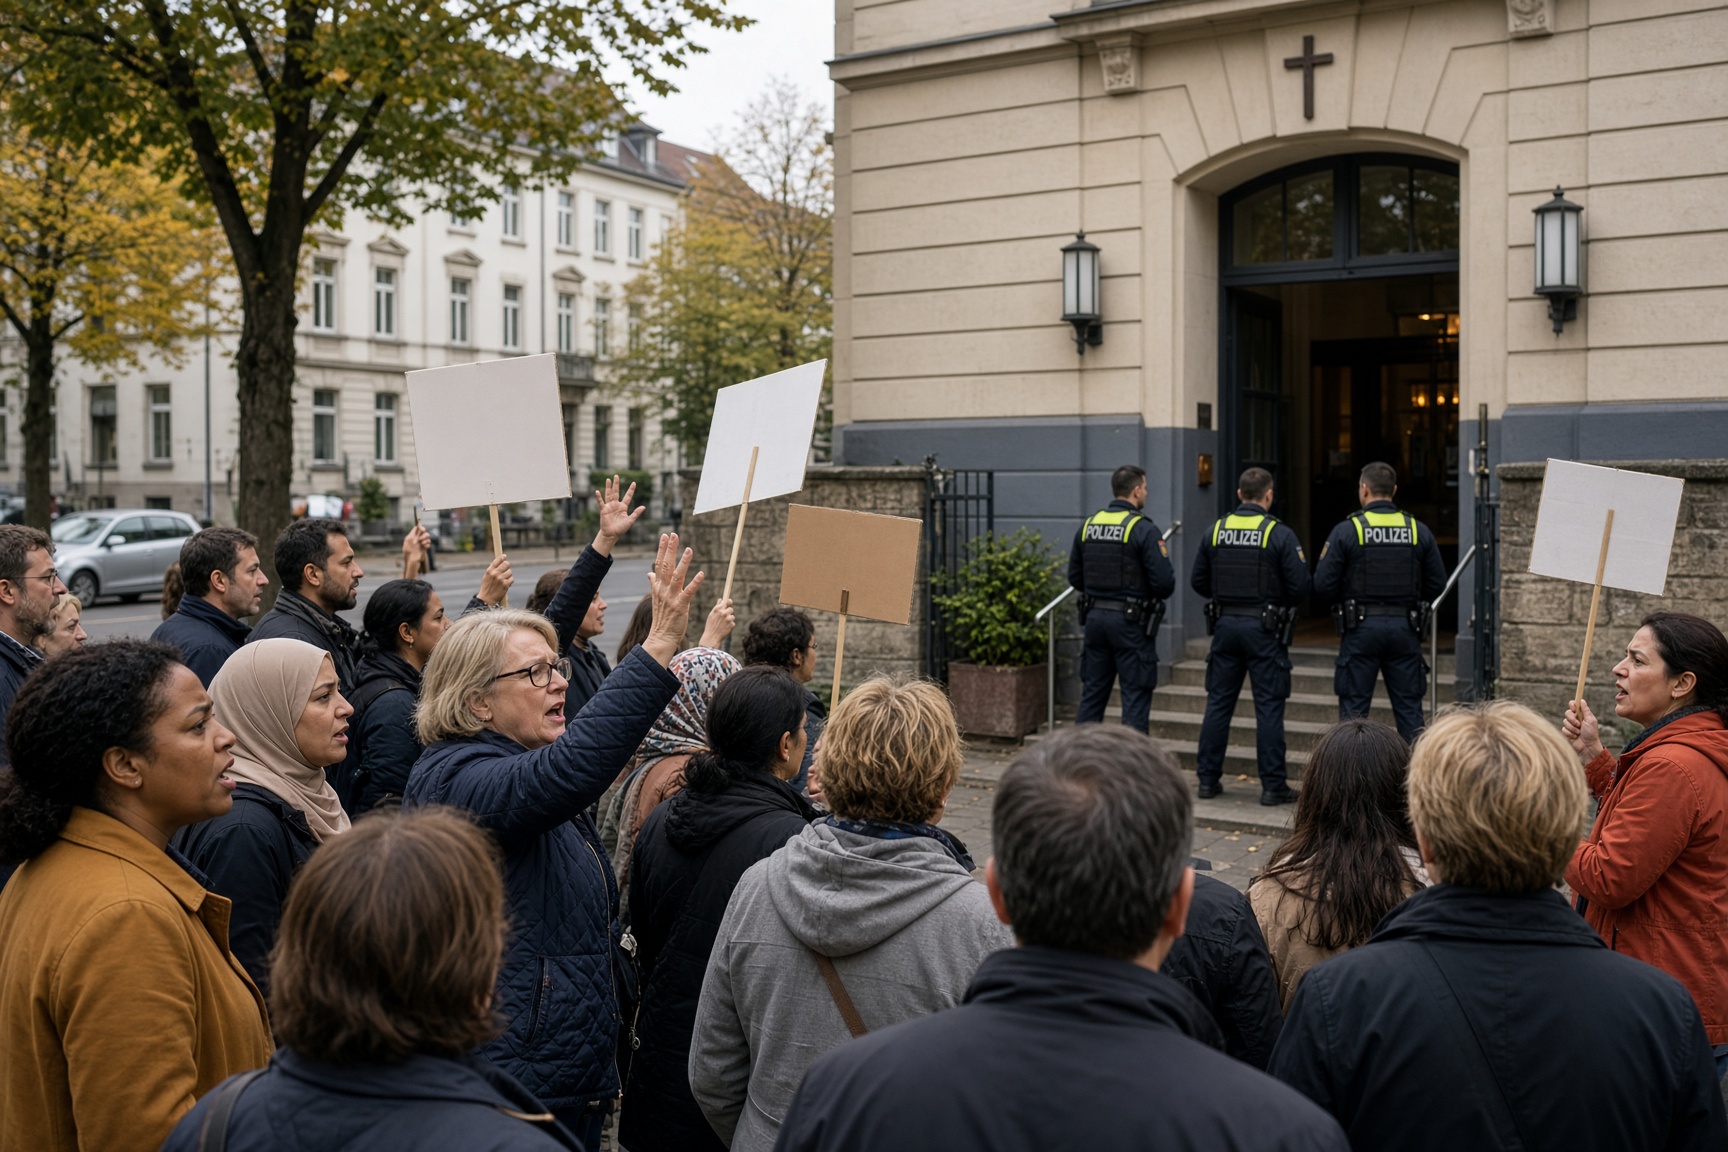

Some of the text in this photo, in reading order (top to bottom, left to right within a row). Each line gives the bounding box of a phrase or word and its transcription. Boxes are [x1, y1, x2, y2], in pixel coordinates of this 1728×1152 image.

[1085, 525, 1124, 541] POLIZEI
[1217, 529, 1262, 547] POLIZEI
[1365, 527, 1412, 544] POLIZEI
